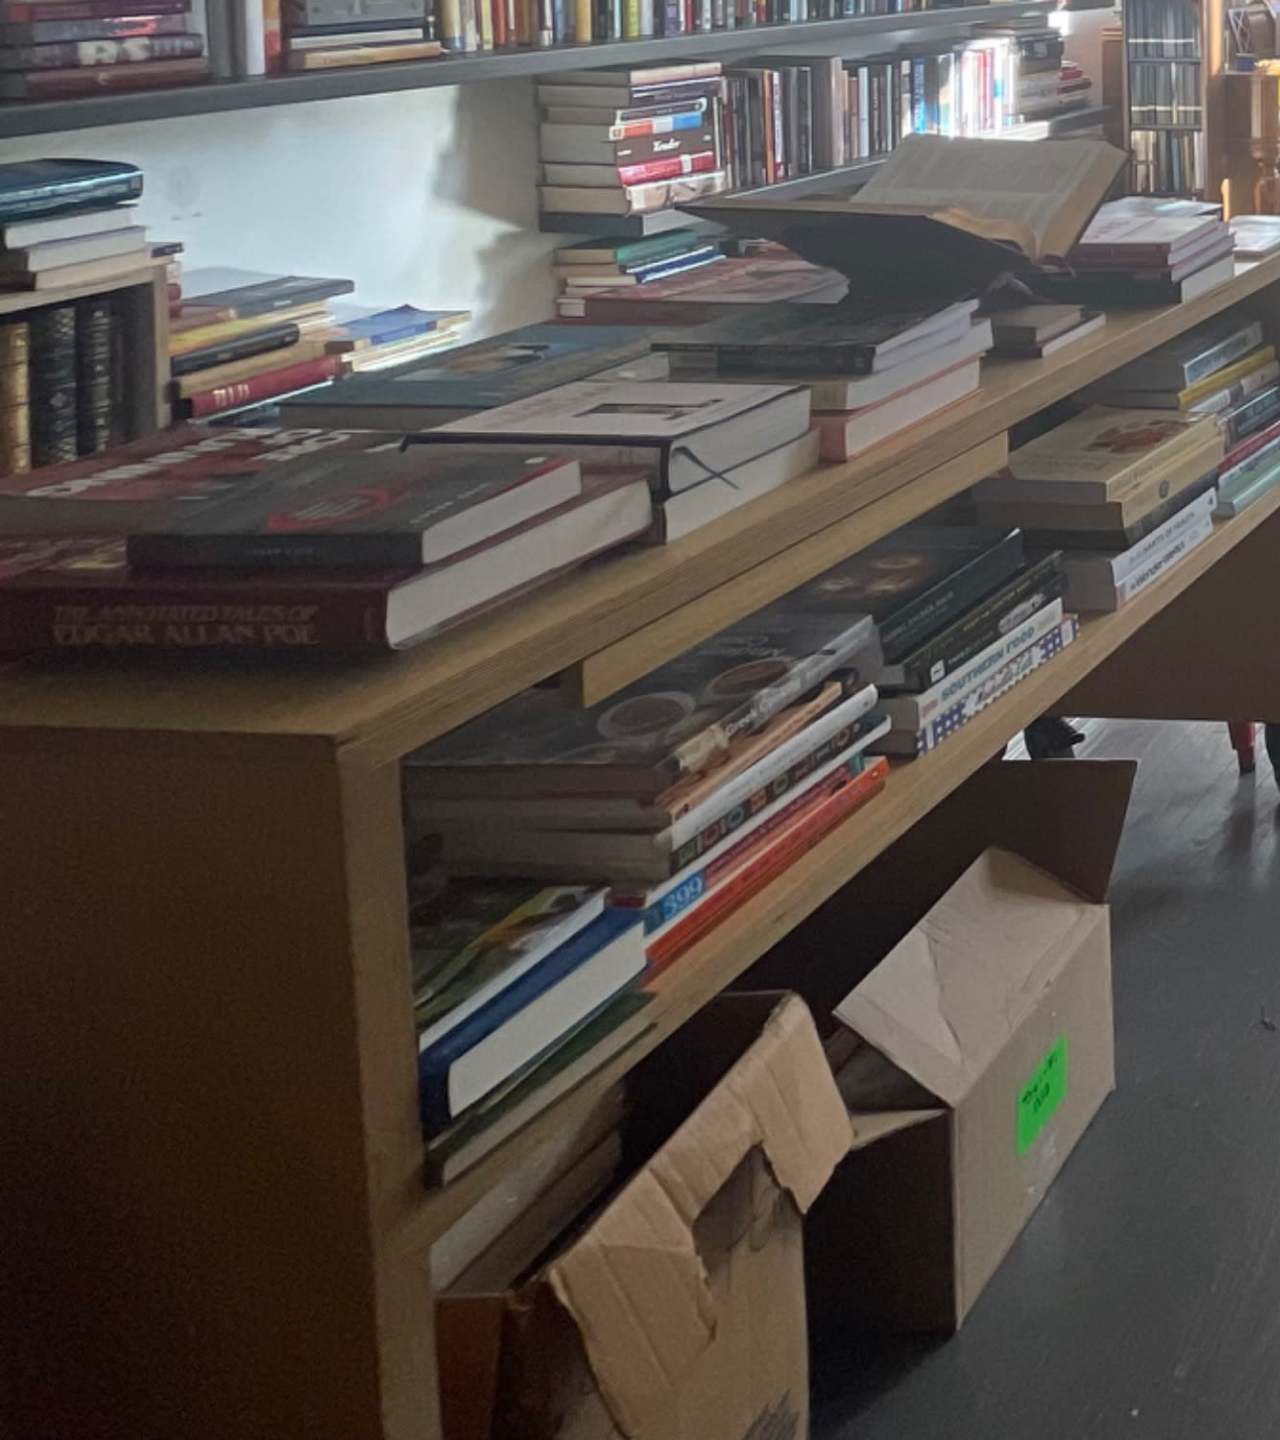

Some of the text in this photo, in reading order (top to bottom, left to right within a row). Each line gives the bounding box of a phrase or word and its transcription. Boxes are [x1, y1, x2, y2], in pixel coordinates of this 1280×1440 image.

[53, 624, 321, 646] EDGAR ALLAN POE
